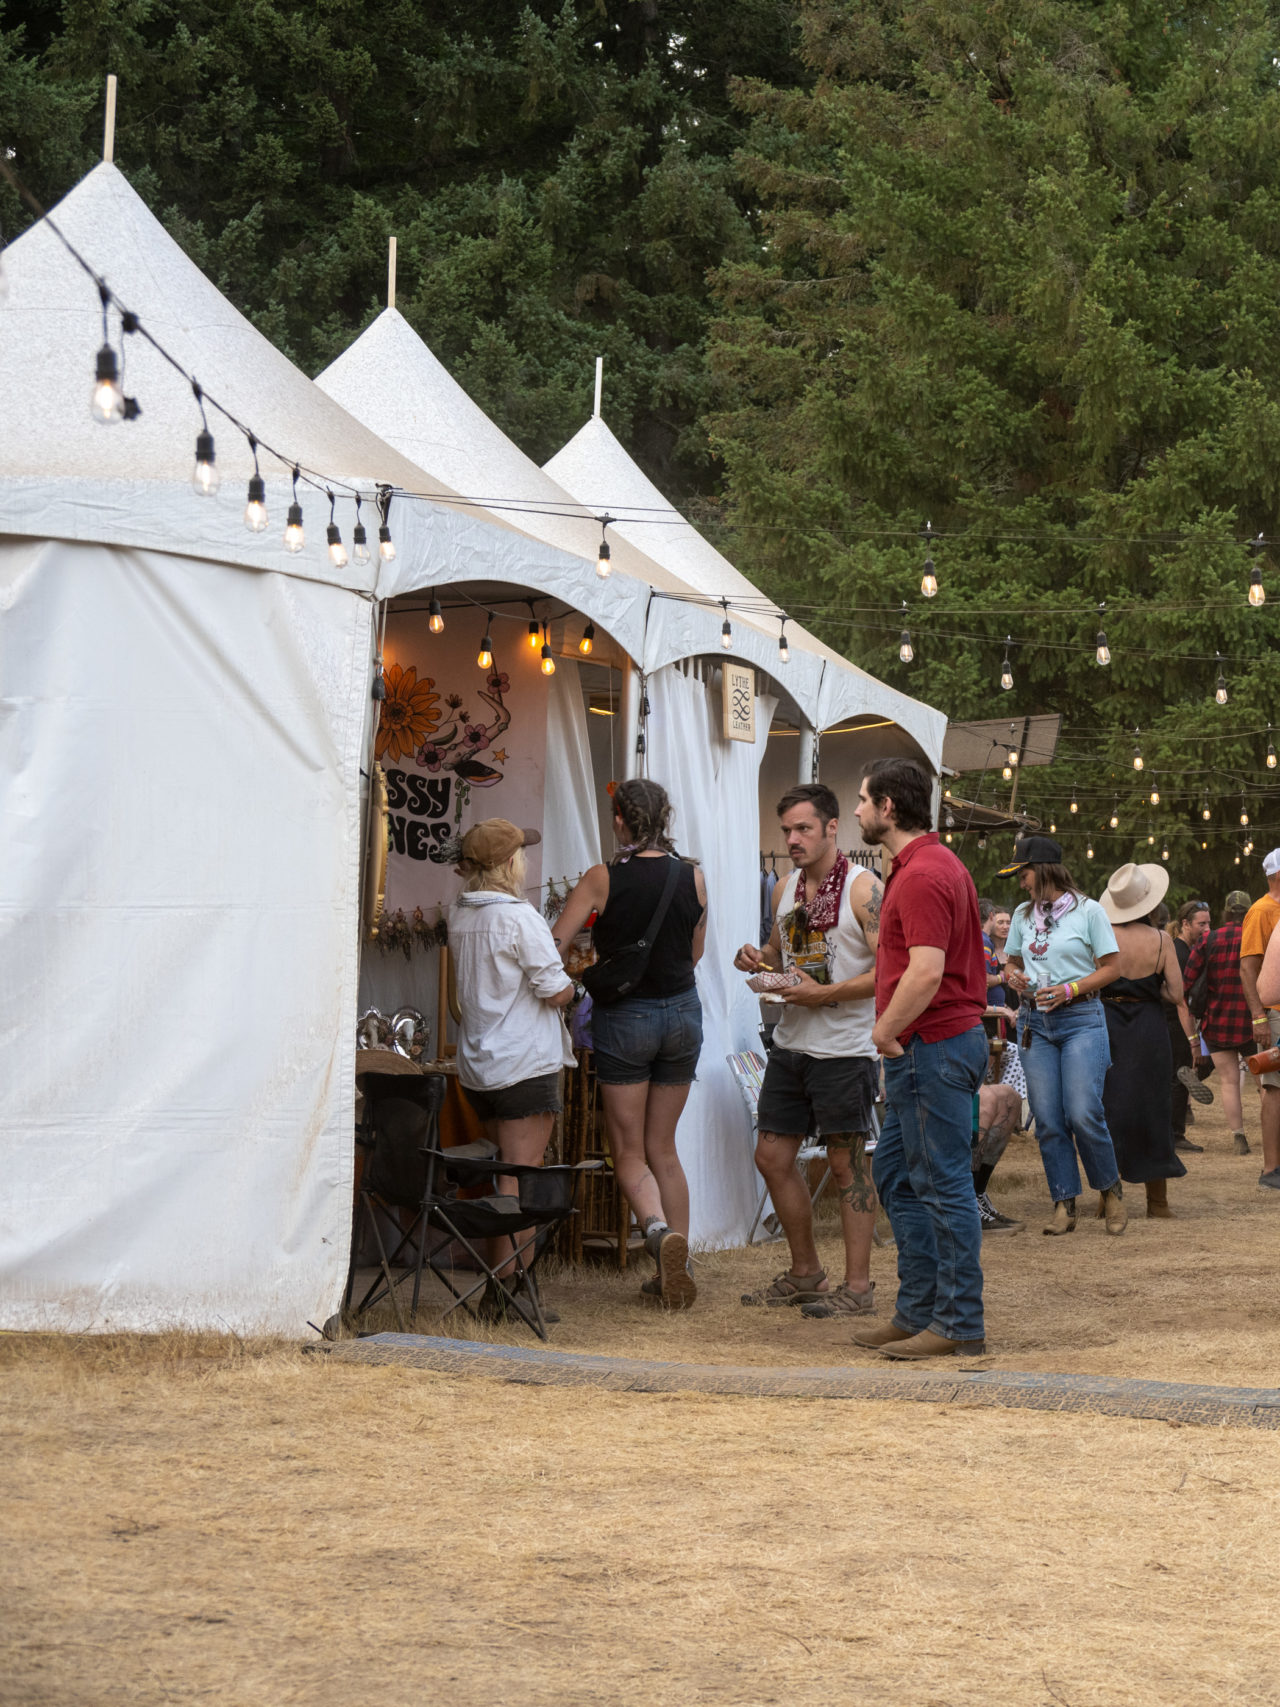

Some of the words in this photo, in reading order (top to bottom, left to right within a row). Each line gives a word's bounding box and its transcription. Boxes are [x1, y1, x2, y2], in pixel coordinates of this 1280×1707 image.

[731, 674, 749, 690] LYTHE
[733, 721, 751, 732] LEATHER
[386, 768, 451, 818] SSY
[387, 812, 452, 864] NES
